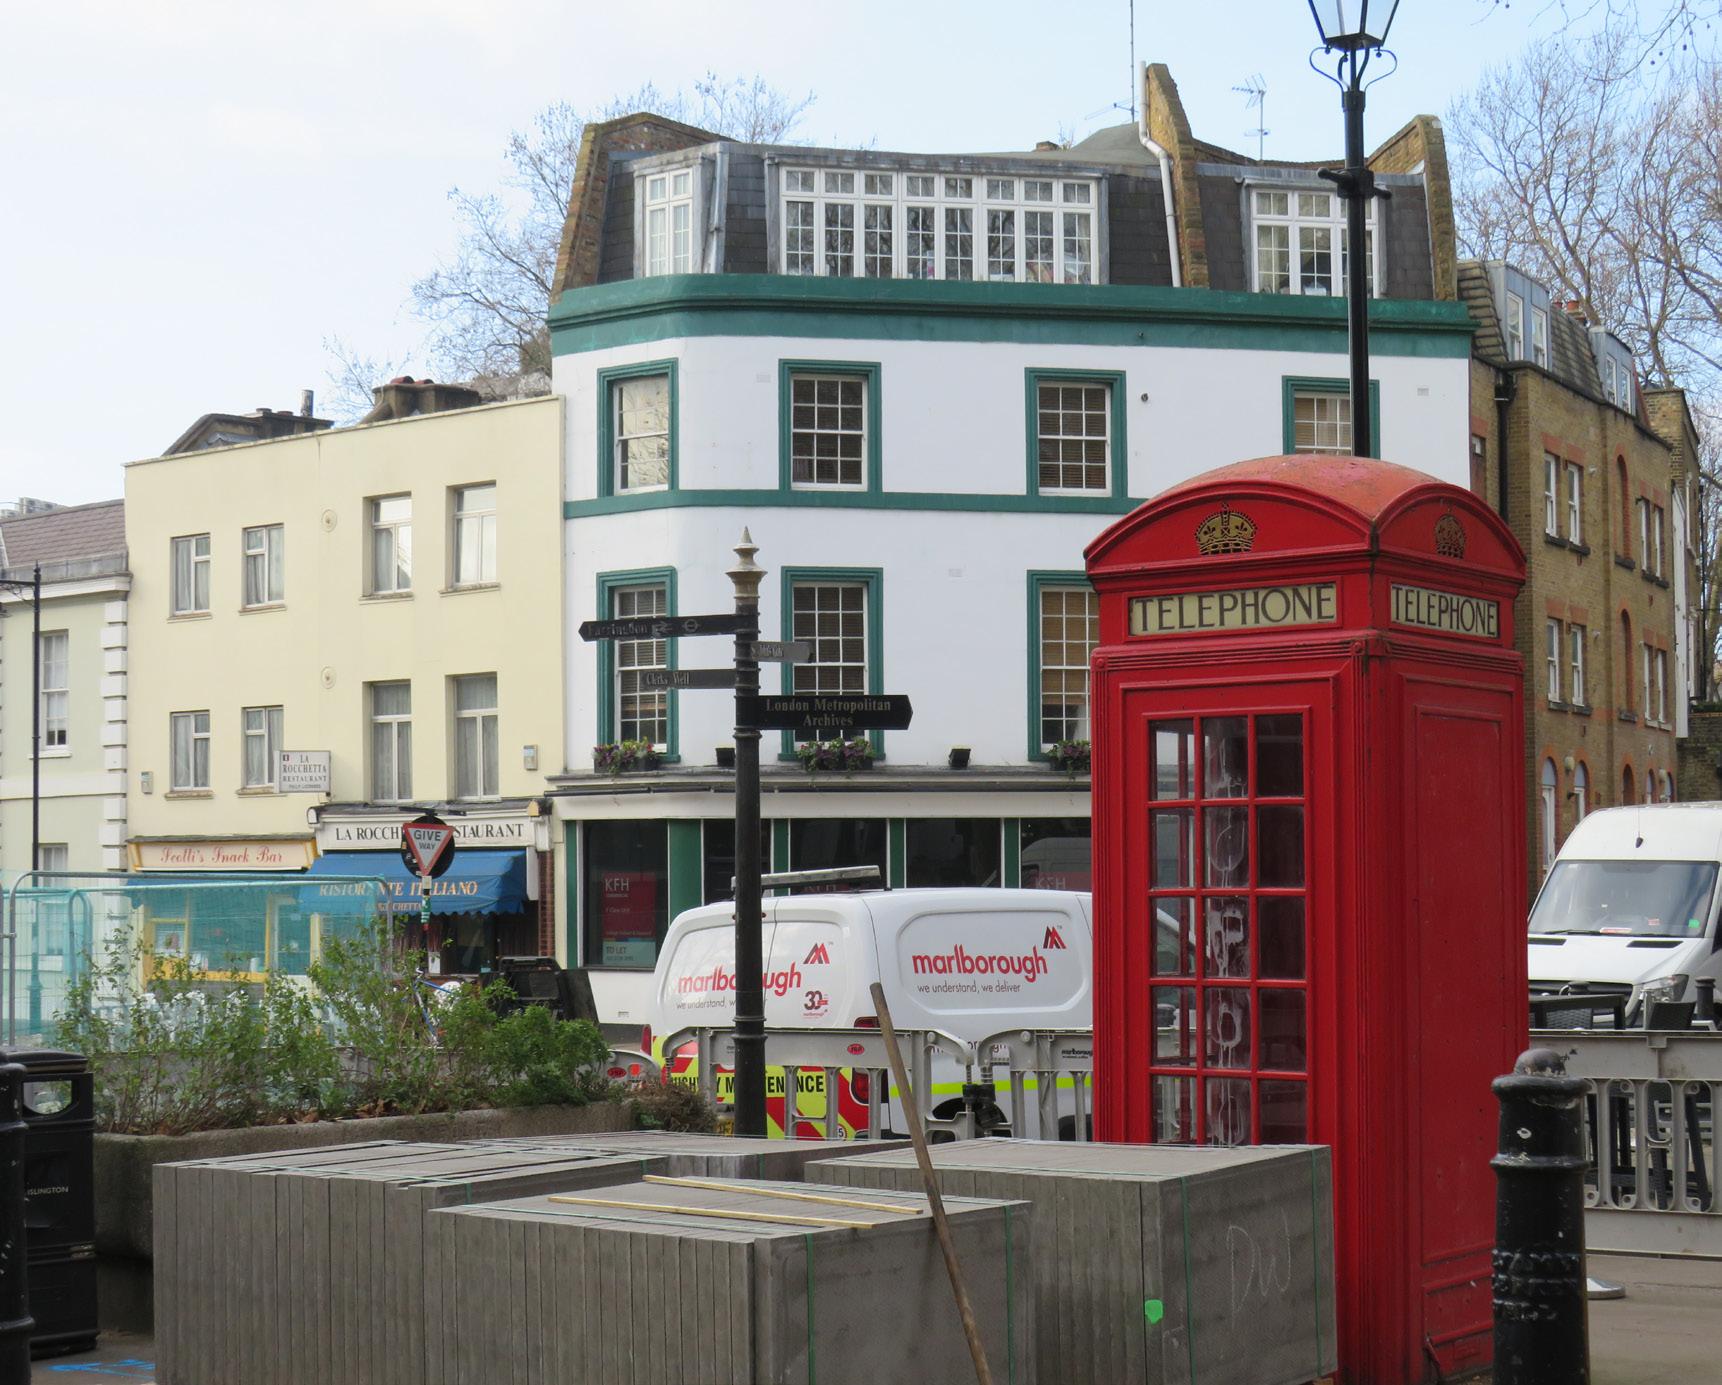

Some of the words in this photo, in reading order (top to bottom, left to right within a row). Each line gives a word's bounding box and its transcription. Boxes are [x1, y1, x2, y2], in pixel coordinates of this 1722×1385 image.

[1134, 585, 1334, 631] TELEPHONE
[1391, 586, 1496, 637] TELEPHONE
[766, 699, 809, 712] London
[814, 698, 891, 716] Metropolitan
[803, 713, 853, 727] Archives
[336, 827, 352, 841] LA
[453, 823, 524, 839] STAURANT
[413, 829, 442, 842] GIVE
[418, 841, 436, 850] WAY
[211, 846, 249, 863] Snack
[256, 846, 283, 863] Bar
[410, 881, 479, 897] ITLIANO
[604, 878, 630, 892] KFH
[912, 944, 1048, 983] marlborough
[917, 984, 930, 993] we
[932, 980, 980, 994] understand,
[982, 984, 994, 993] we
[995, 980, 1021, 993] deliver
[676, 1001, 687, 1009] we
[27, 1186, 69, 1195] ISLINGTON
